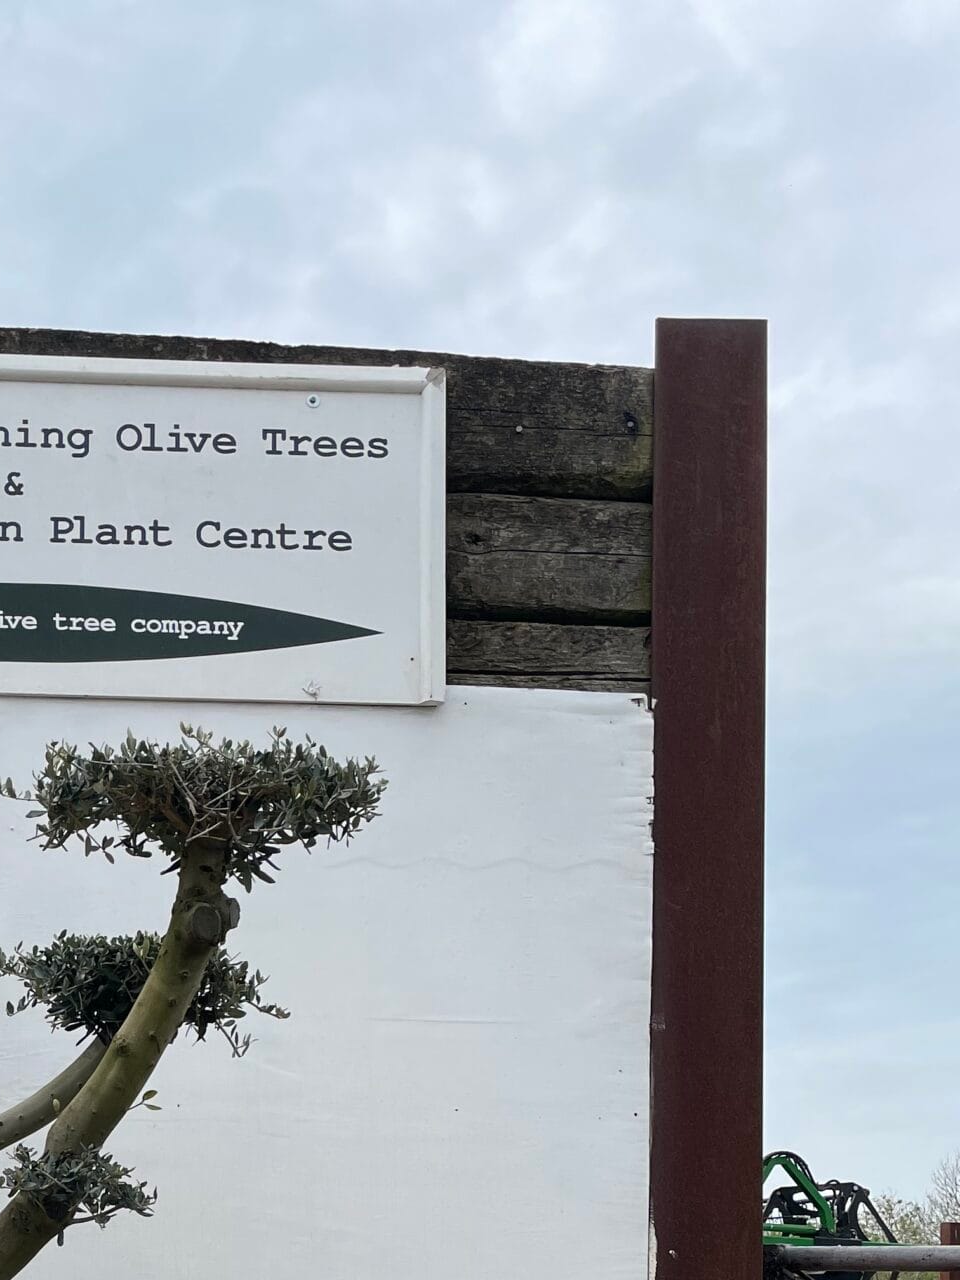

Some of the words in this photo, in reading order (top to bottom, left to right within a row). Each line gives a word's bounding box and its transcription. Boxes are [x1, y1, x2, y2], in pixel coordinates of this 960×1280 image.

[117, 423, 236, 454] Olive
[262, 429, 389, 458] Trees
[4, 472, 24, 496] &
[49, 516, 172, 547] Plant
[196, 521, 353, 551] Centre
[53, 613, 117, 632] tree
[131, 619, 244, 641] company
